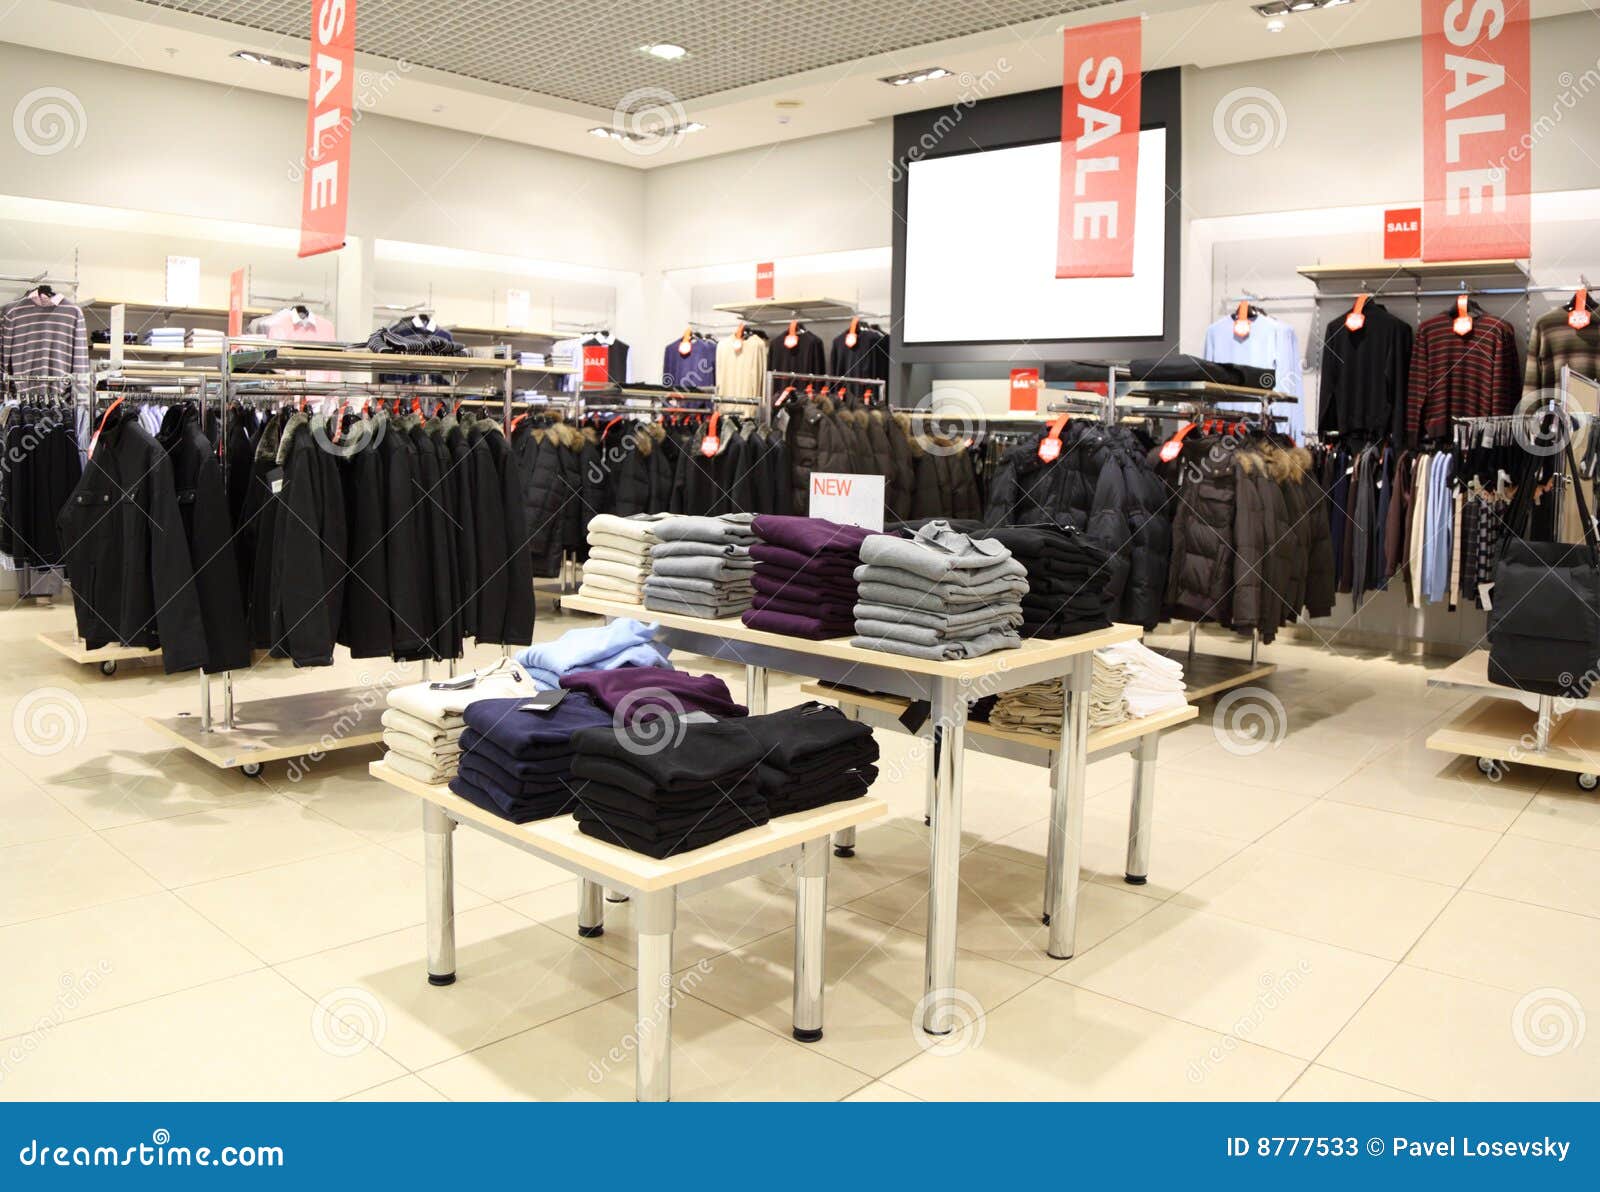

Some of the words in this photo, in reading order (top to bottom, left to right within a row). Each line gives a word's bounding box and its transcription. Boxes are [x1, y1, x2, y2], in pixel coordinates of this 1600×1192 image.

[311, 0, 345, 211] SALE
[1073, 56, 1124, 240] SALE
[1443, 0, 1506, 216] SALE
[1387, 221, 1418, 232] SALE
[585, 358, 606, 367] SALE
[813, 478, 852, 496] NEW
